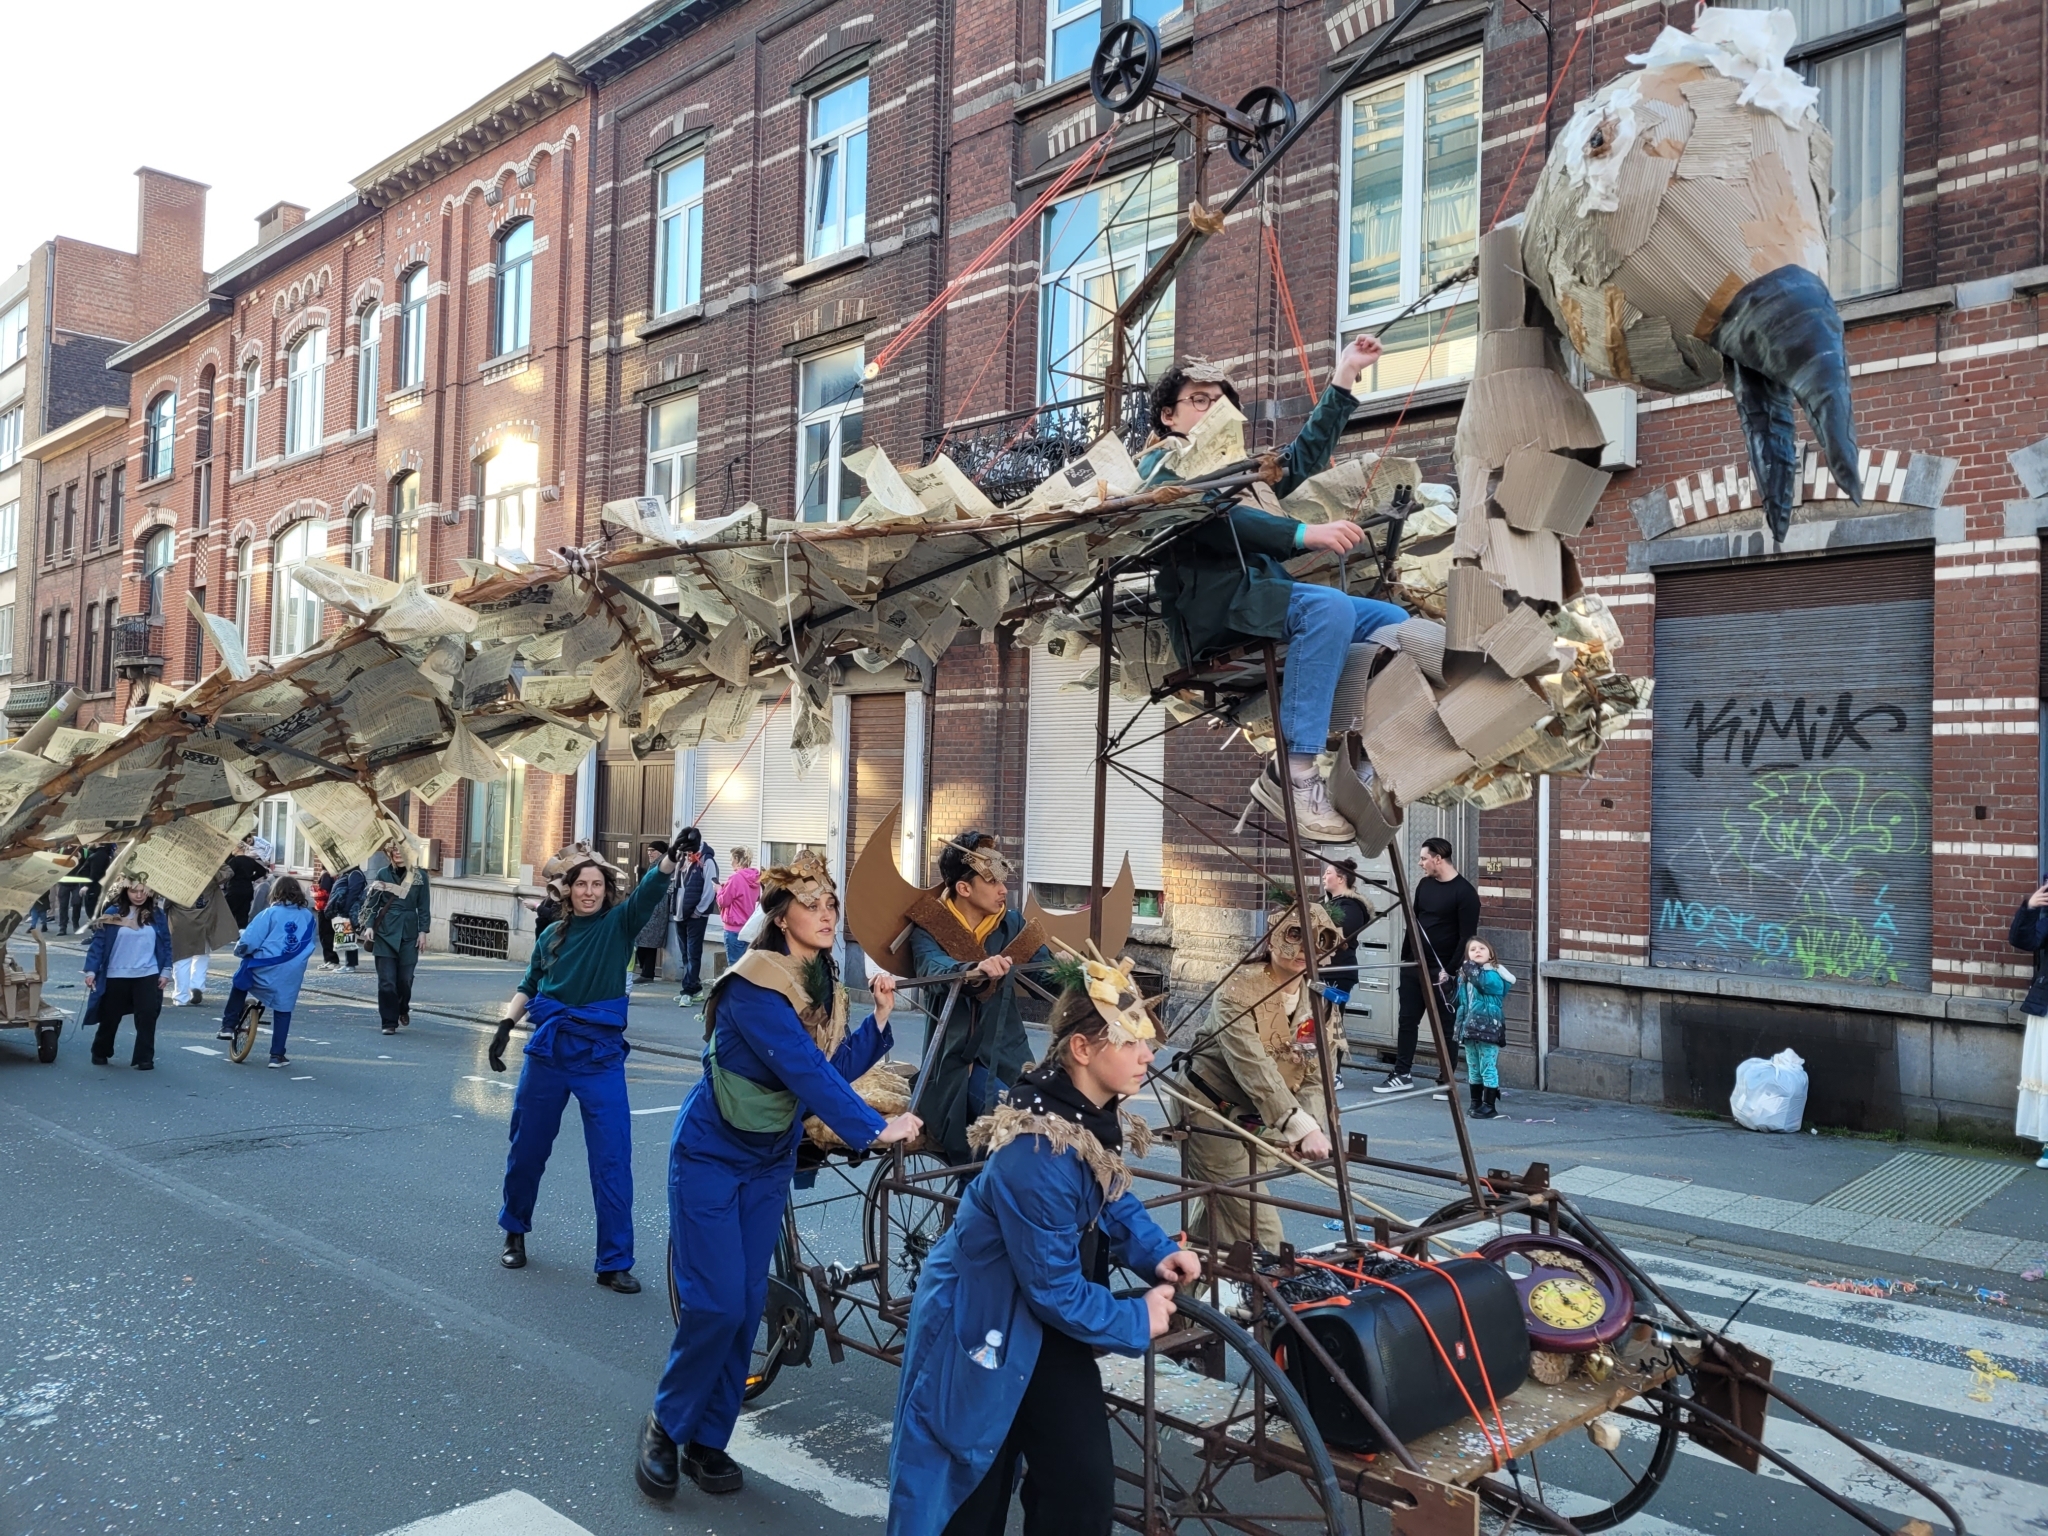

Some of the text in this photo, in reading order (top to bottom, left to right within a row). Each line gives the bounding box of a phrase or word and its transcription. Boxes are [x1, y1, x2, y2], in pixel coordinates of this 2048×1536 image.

[1565, 1280, 1576, 1288] 8
[1588, 1293, 1599, 1301] 10
[1591, 1302, 1602, 1311] 11
[1542, 1312, 1553, 1320] 3
[1582, 1311, 1596, 1321] 12
[1555, 1318, 1567, 1326] 2
